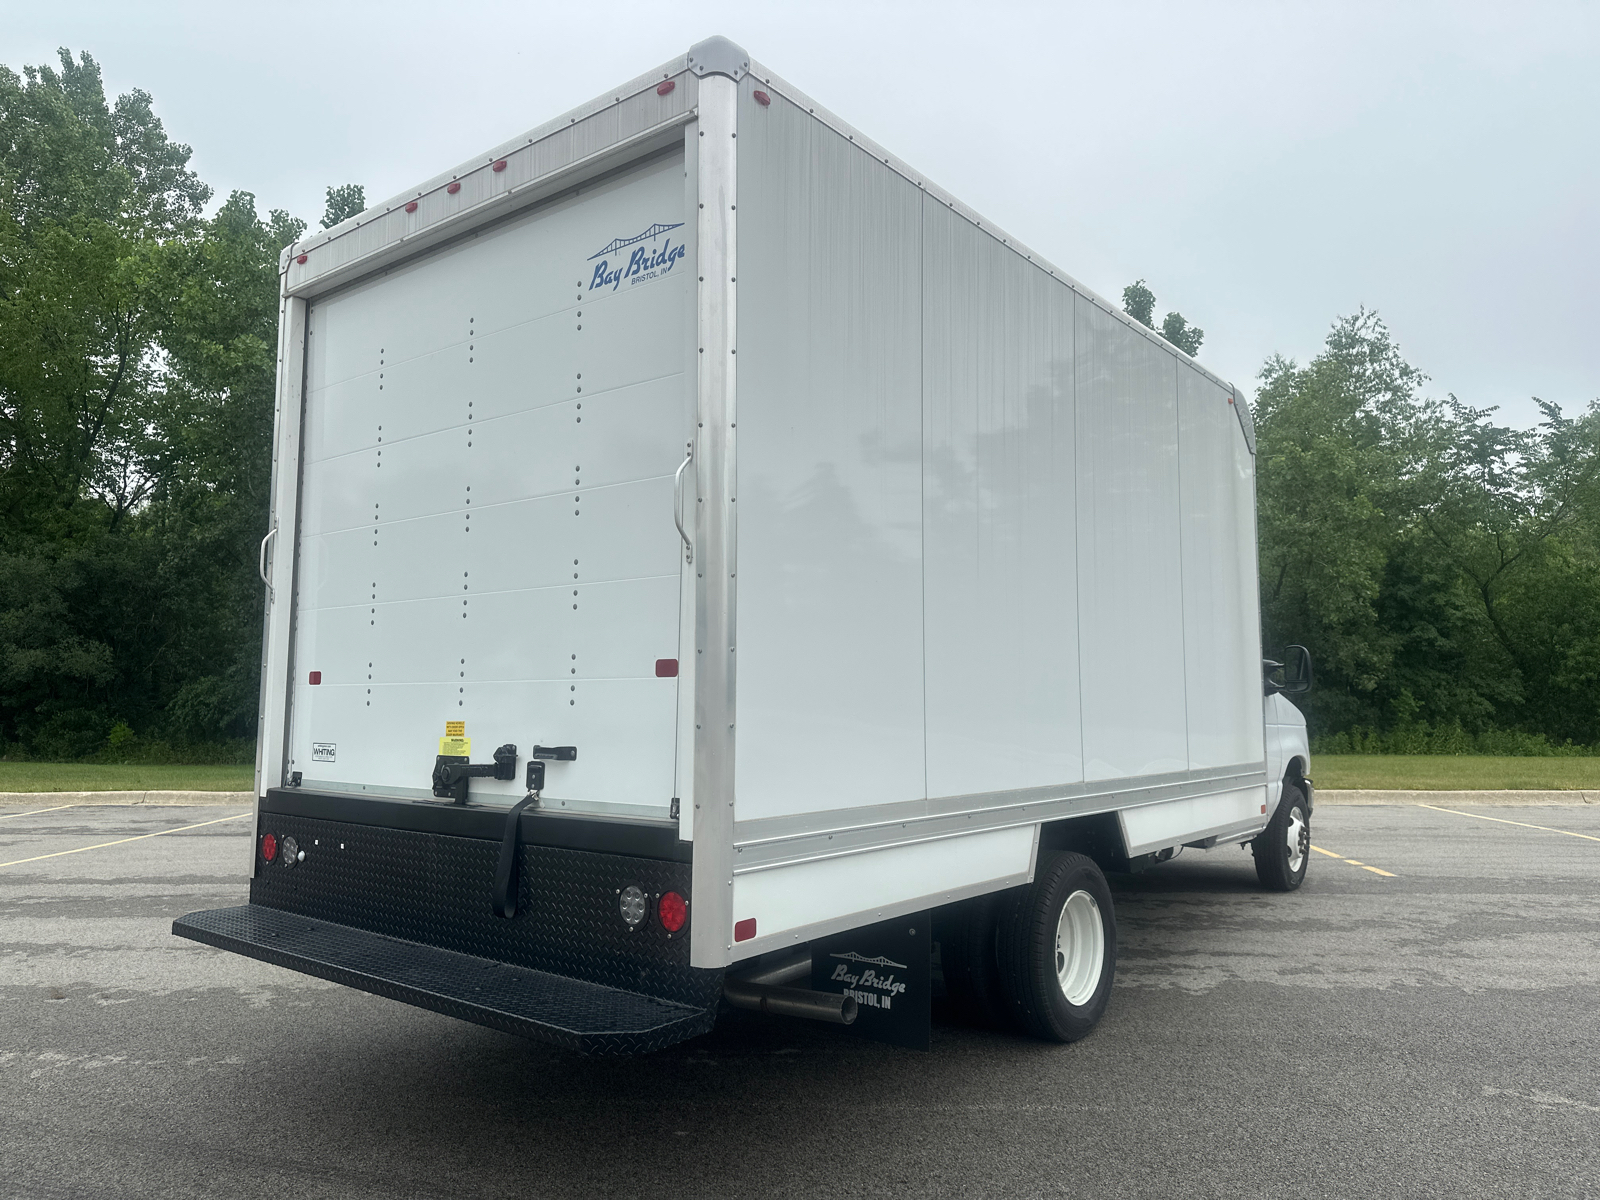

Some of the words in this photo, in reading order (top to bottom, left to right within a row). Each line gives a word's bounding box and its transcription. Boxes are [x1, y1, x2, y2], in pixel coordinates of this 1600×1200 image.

[588, 260, 623, 291] Bay
[624, 238, 685, 279] Bridge
[660, 267, 669, 276] IN
[830, 964, 860, 988] Bay
[859, 969, 906, 997] Bridge
[881, 995, 891, 1010] IN
